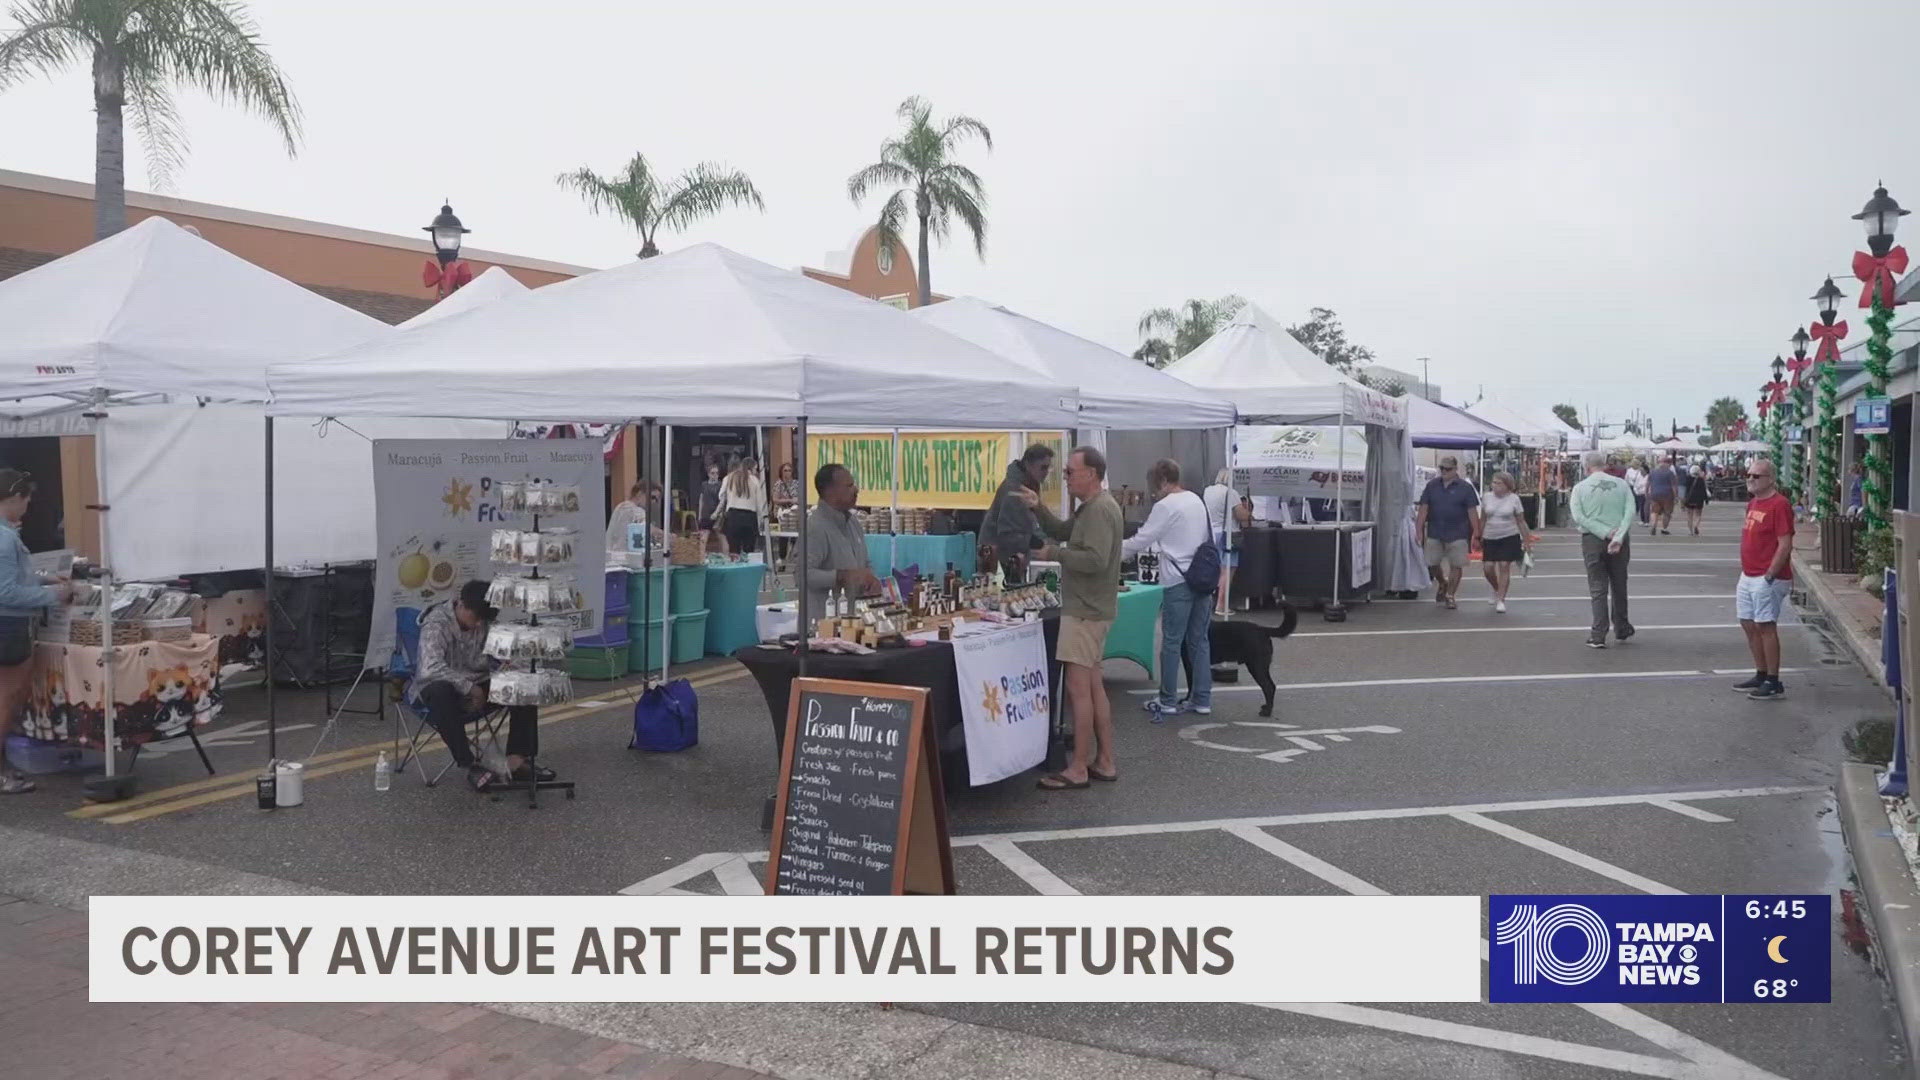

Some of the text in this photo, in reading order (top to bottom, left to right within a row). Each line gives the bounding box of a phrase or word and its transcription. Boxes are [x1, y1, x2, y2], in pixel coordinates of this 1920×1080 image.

[461, 452, 500, 464] Passion
[504, 452, 528, 464] Fruit
[903, 440, 929, 492] DOG
[932, 439, 982, 493] TREATS
[1263, 467, 1300, 476] ACCLAIM
[1001, 666, 1045, 698] Passion
[865, 701, 893, 713] Honey
[800, 757, 824, 770] Fresh
[852, 762, 875, 776] Fresh
[822, 787, 842, 804] Dried
[794, 800, 818, 815] Jerky
[799, 813, 829, 828] Sauces
[792, 826, 821, 842] Original
[866, 856, 890, 872] Ginger
[791, 869, 807, 881] Cold
